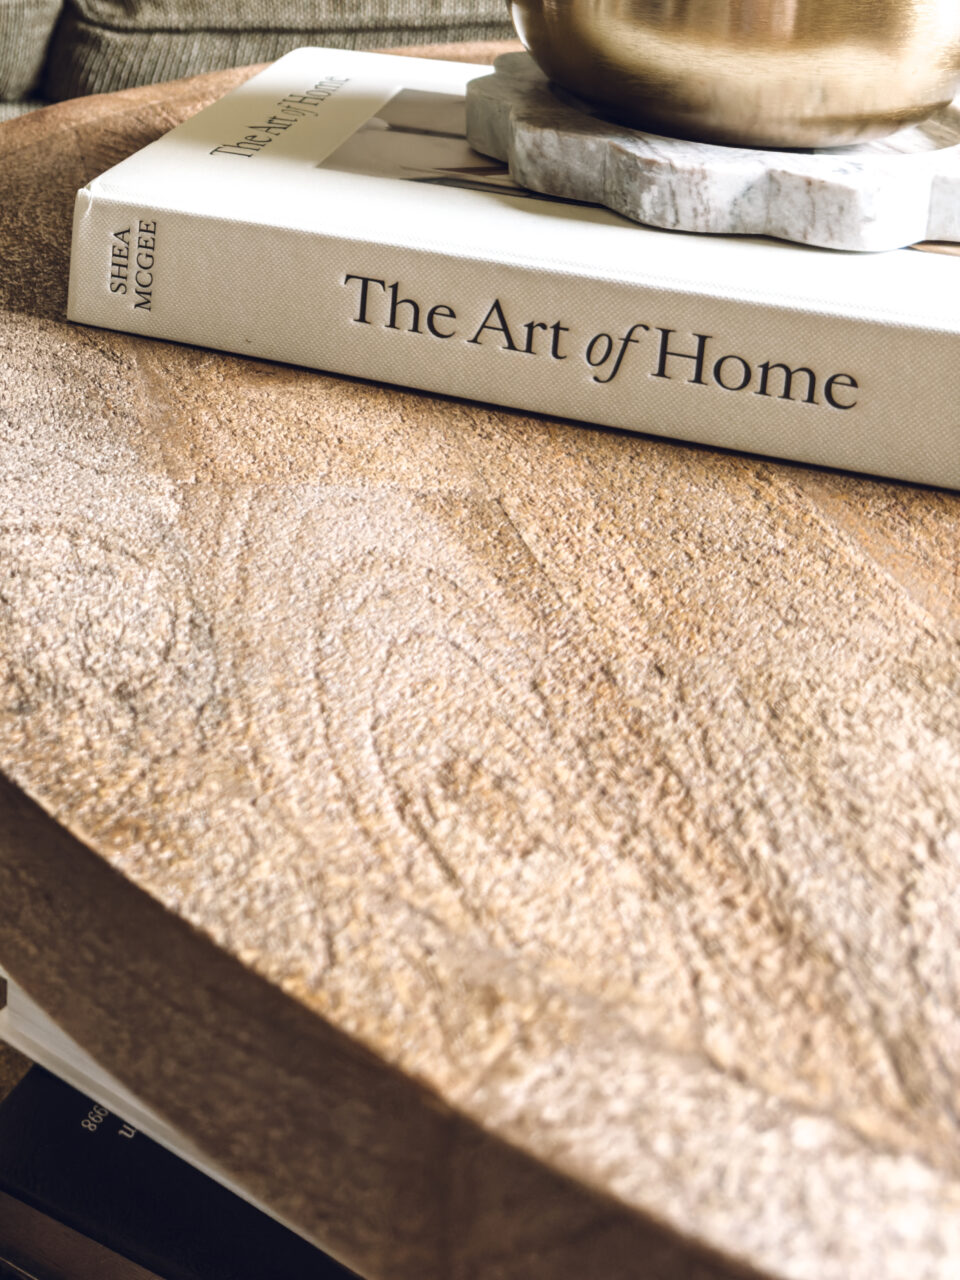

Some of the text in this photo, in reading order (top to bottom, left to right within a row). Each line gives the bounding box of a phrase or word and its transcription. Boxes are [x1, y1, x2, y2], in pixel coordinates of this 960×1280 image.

[209, 76, 350, 158] The Art of Home
[109, 226, 131, 295] SHEA
[134, 220, 157, 312] MCGEE
[343, 273, 860, 411] The Art of Home
